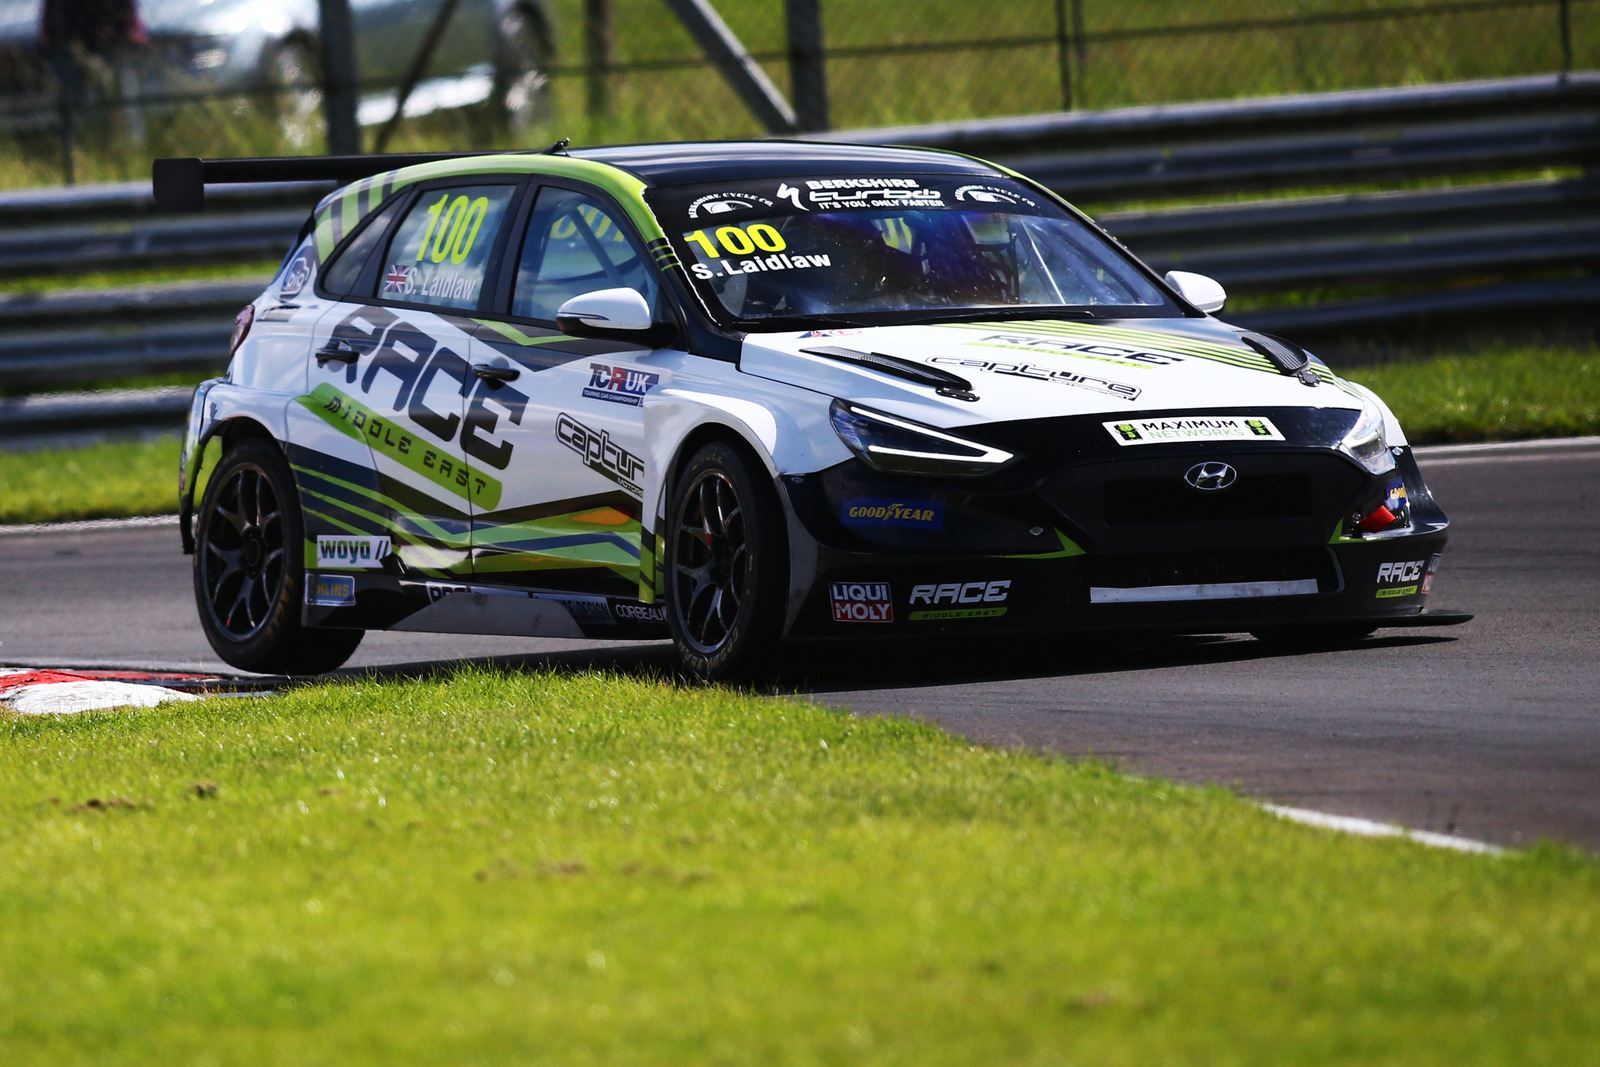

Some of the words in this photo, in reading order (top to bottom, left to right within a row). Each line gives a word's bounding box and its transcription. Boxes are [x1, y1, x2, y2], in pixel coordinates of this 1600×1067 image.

[806, 179, 919, 189] BERKSHIRE
[722, 192, 758, 200] CYCLE
[818, 201, 841, 209] IT'S
[844, 200, 870, 208] YOU,
[873, 199, 901, 207] ONLY
[901, 199, 945, 207] FASTER
[416, 194, 489, 265] 100
[683, 223, 787, 258] 100
[421, 269, 477, 300] Laidlaw
[979, 335, 1186, 365] RACE
[929, 356, 1138, 397] capture
[327, 305, 530, 470] RACE
[1141, 420, 1239, 431] MAXIMUM
[1149, 428, 1245, 439] NETWORKS
[324, 396, 412, 454] MIDDLE
[423, 450, 486, 495] EAST
[1377, 560, 1425, 583] RACE
[309, 579, 350, 597] HLINS
[832, 584, 888, 601] LIQUI
[909, 580, 1011, 604] RACE
[615, 604, 663, 620] CORBEAU
[835, 603, 892, 620] MOLY
